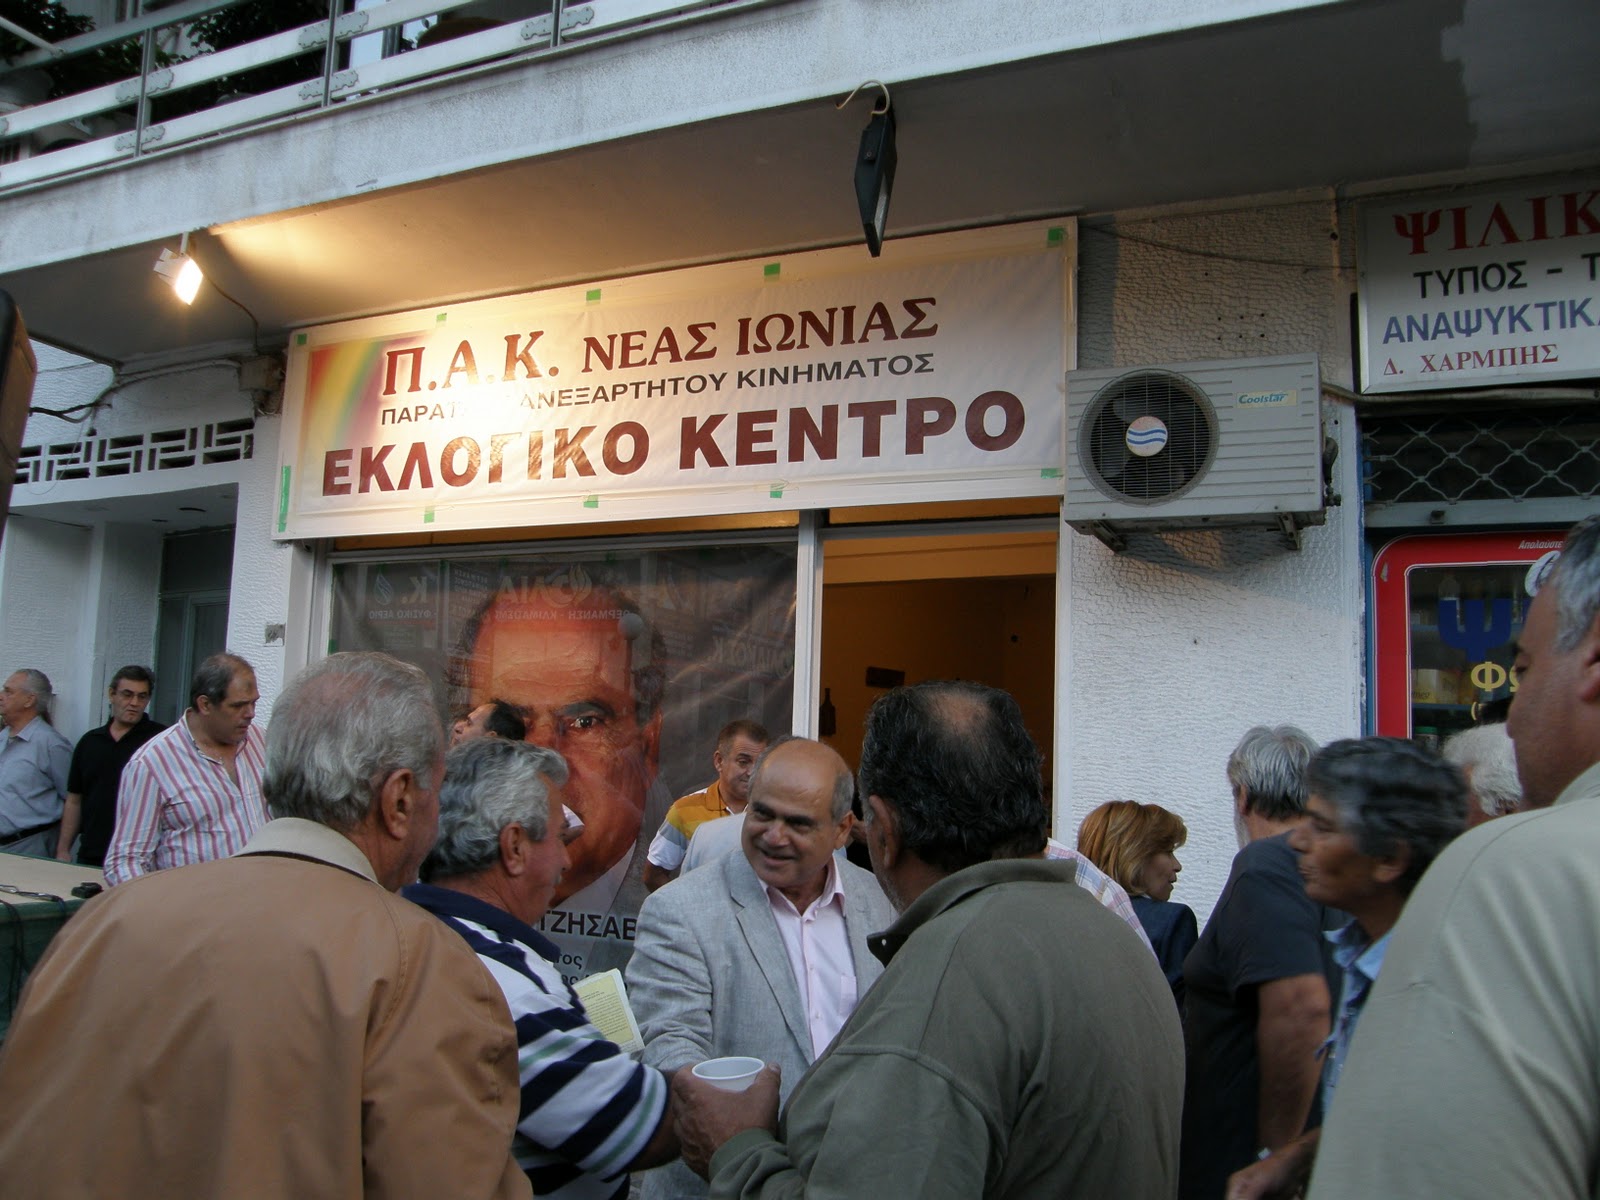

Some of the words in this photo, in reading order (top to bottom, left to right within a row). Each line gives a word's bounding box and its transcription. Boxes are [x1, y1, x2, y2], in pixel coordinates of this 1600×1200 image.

[1392, 190, 1600, 255] ΨΙΛΙΚ
[1413, 260, 1527, 298] ΤΥΠΟΣ
[382, 330, 560, 396] Π.Α.Κ.
[581, 322, 717, 373] ΝΕΑΣ
[736, 297, 939, 356] ΙΩΝΙΑΣ
[1383, 297, 1600, 344] ΑΝΑΨΥΚΤΙΚ
[520, 372, 727, 410] ΑΝΕΞΑΡΤΗΤΟΥ
[737, 353, 935, 389] ΚΙΝΗΜΑΤΟΣ
[1383, 358, 1403, 375] Δ.
[1420, 344, 1559, 373] ΧΑΡΜΠΗΣ
[1238, 392, 1289, 404] Coolstar
[322, 421, 650, 496] ΕΚΛΟΓΙΚΟ
[679, 390, 1026, 470] ΚΕΝΤΡΟ
[1438, 597, 1531, 662] Ψ
[556, 953, 582, 970] ος
